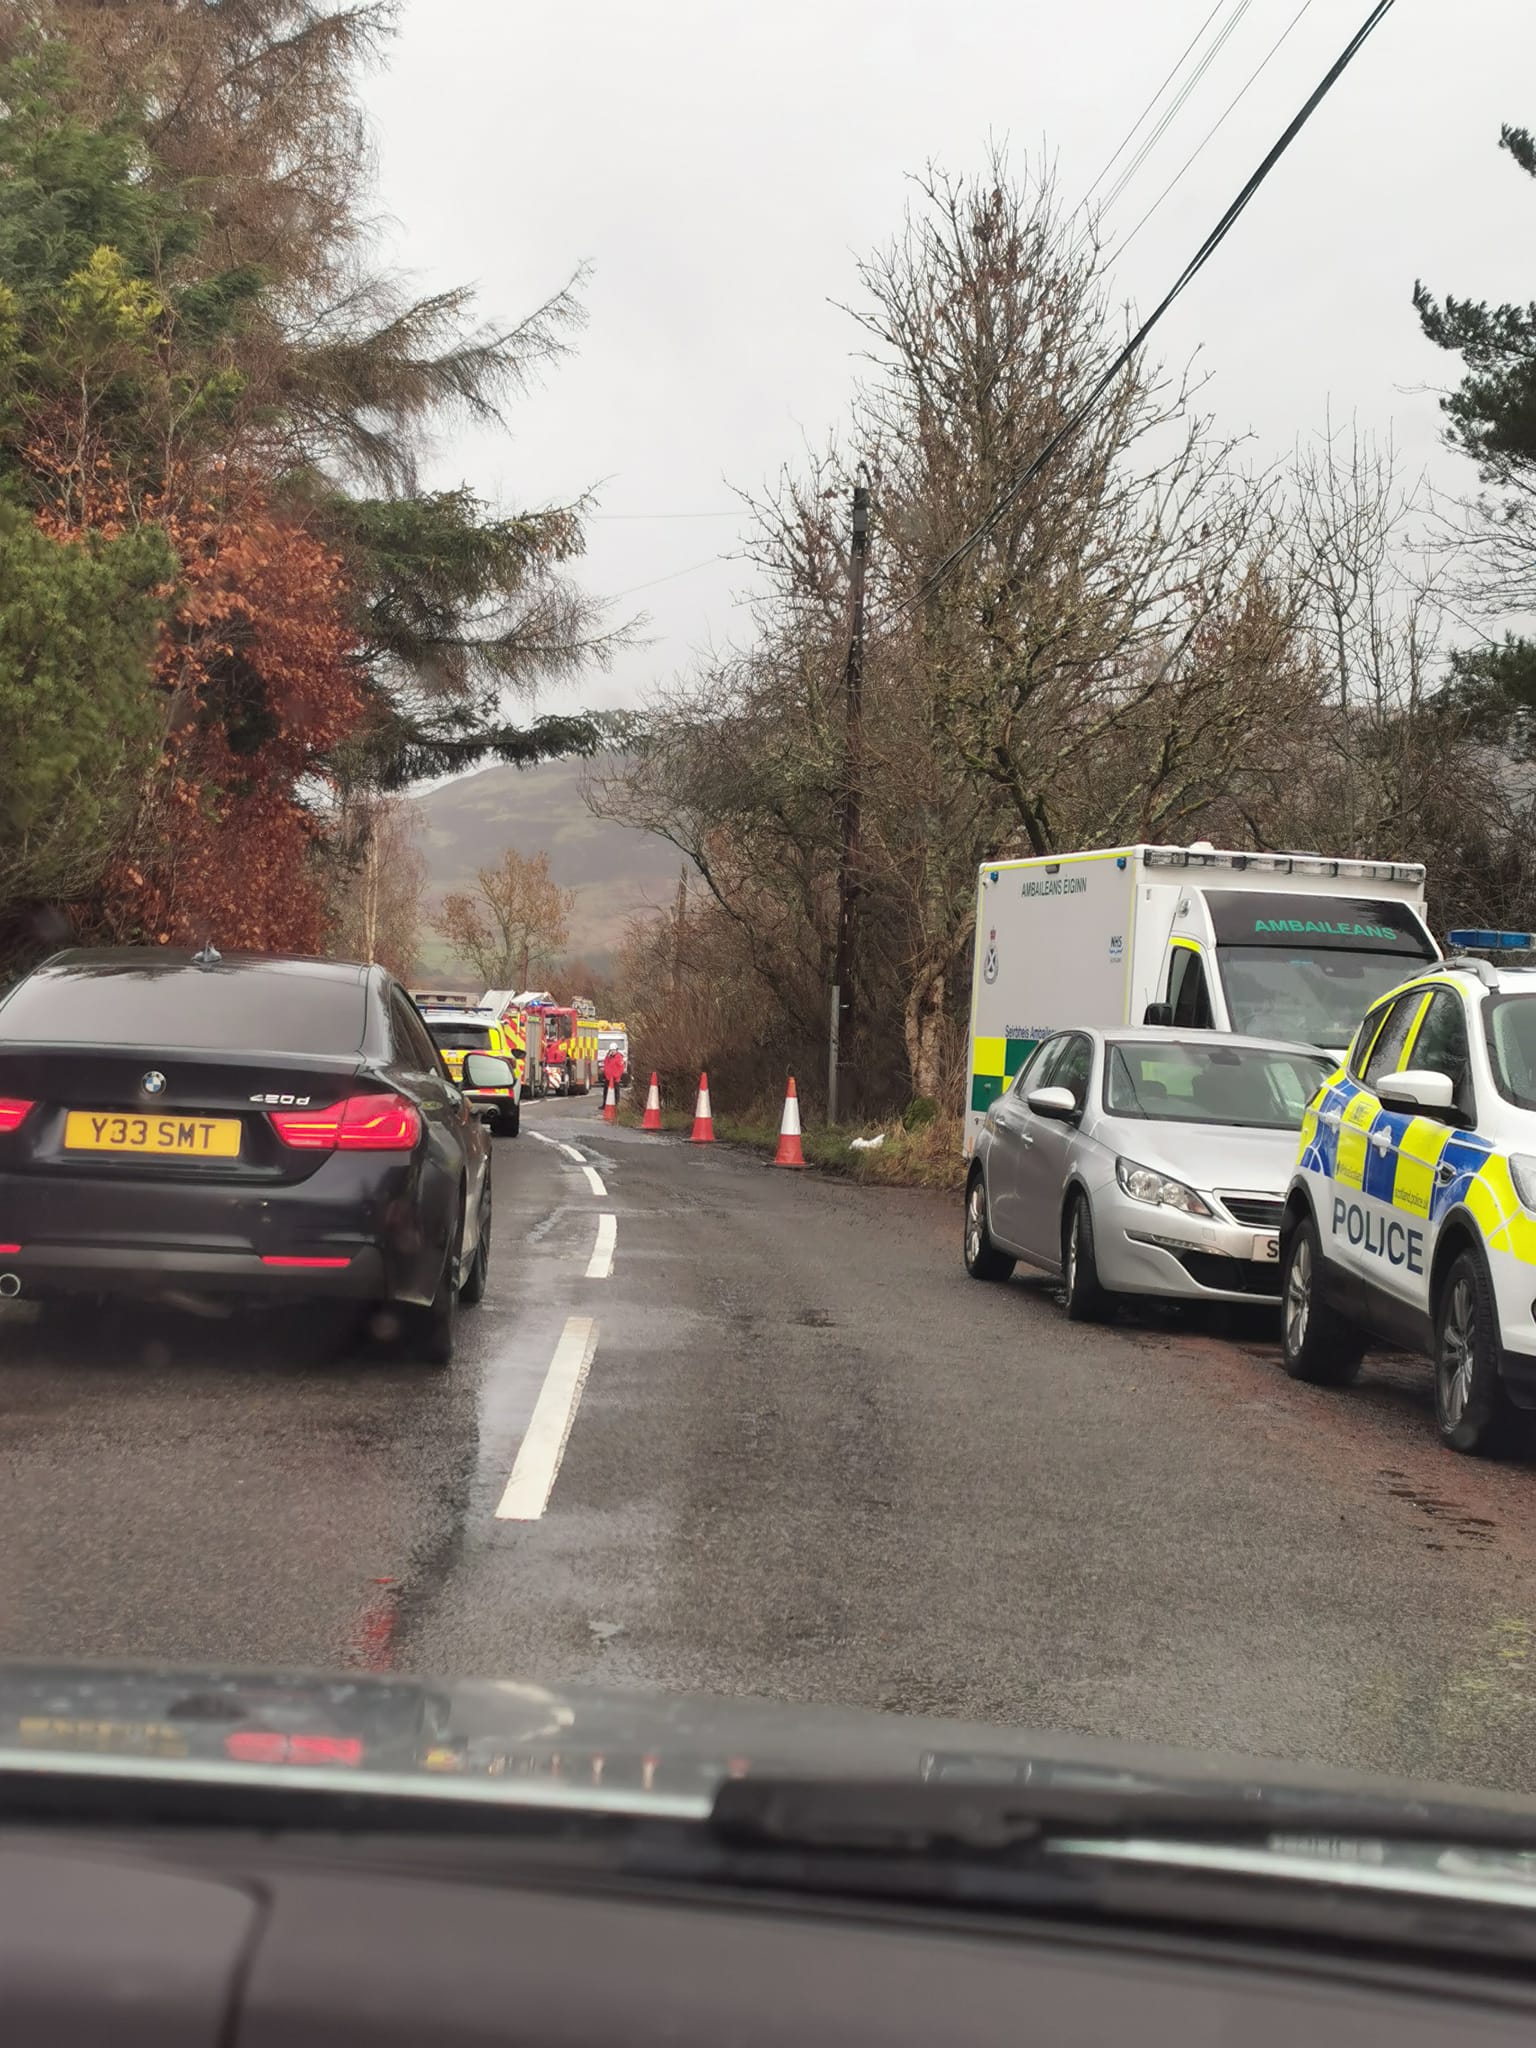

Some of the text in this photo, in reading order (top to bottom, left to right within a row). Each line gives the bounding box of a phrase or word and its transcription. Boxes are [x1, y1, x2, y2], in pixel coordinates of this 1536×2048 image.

[1021, 879, 1062, 897] AMBAILEANS
[1255, 919, 1397, 940] AMBAILEANS
[250, 1094, 310, 1106] 420d
[92, 1117, 216, 1150] Y33 SMT
[1332, 1196, 1423, 1275] POLICE
